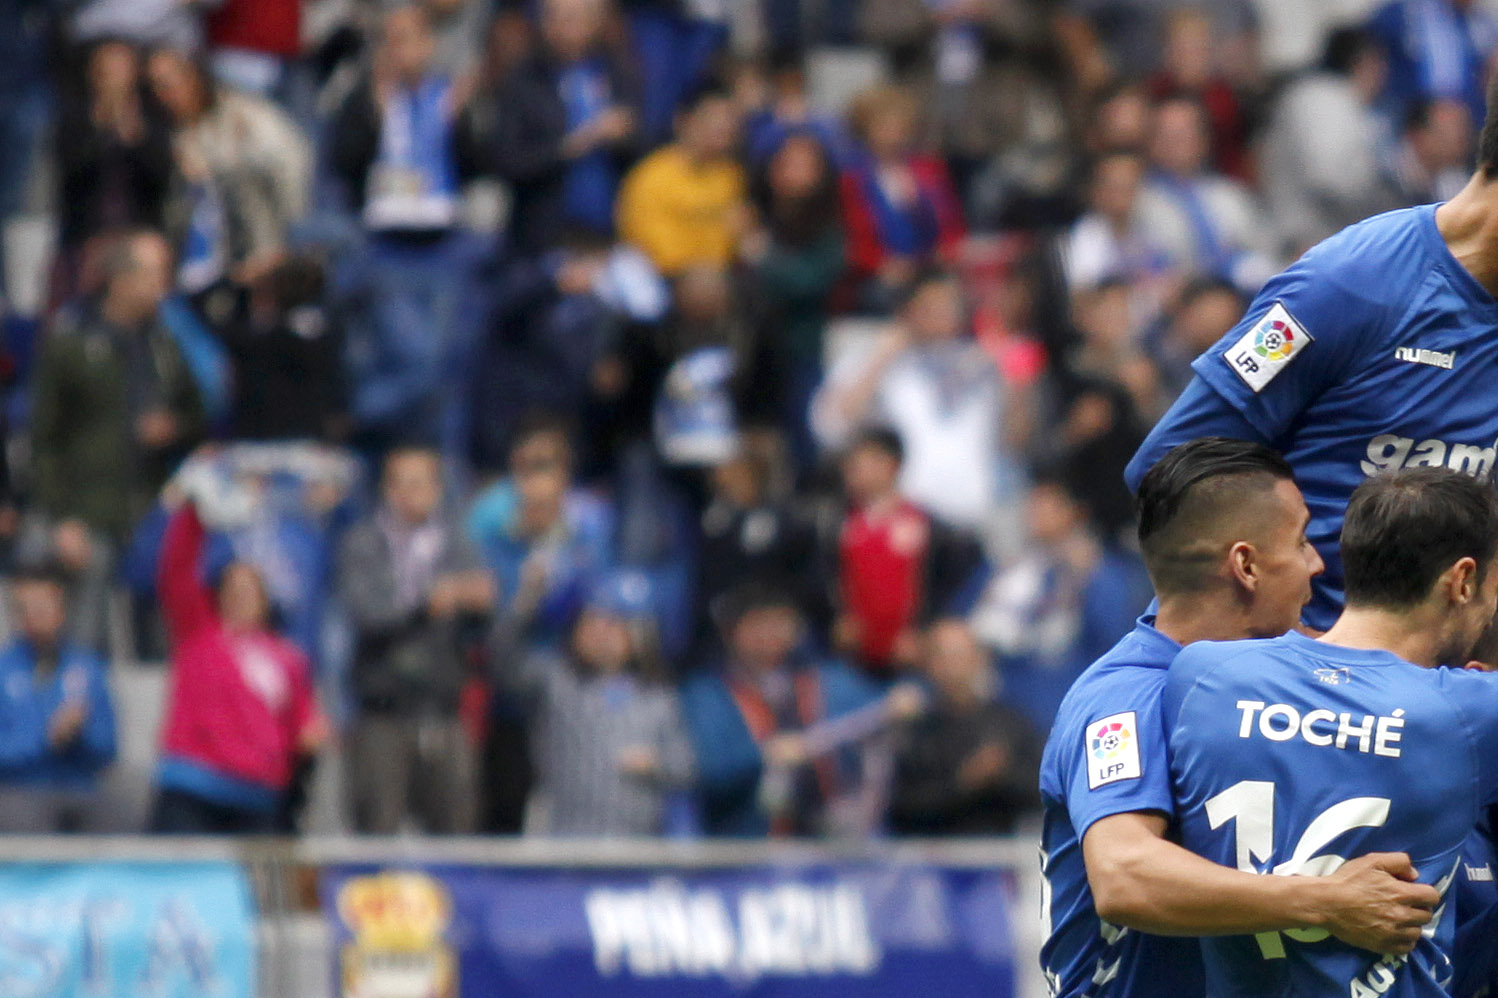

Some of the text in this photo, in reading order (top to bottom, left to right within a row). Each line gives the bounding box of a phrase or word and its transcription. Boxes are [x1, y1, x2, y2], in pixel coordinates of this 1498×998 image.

[1235, 351, 1259, 374] LFP
[1236, 700, 1405, 758] TOCHÉ
[1099, 762, 1125, 780] LFP
